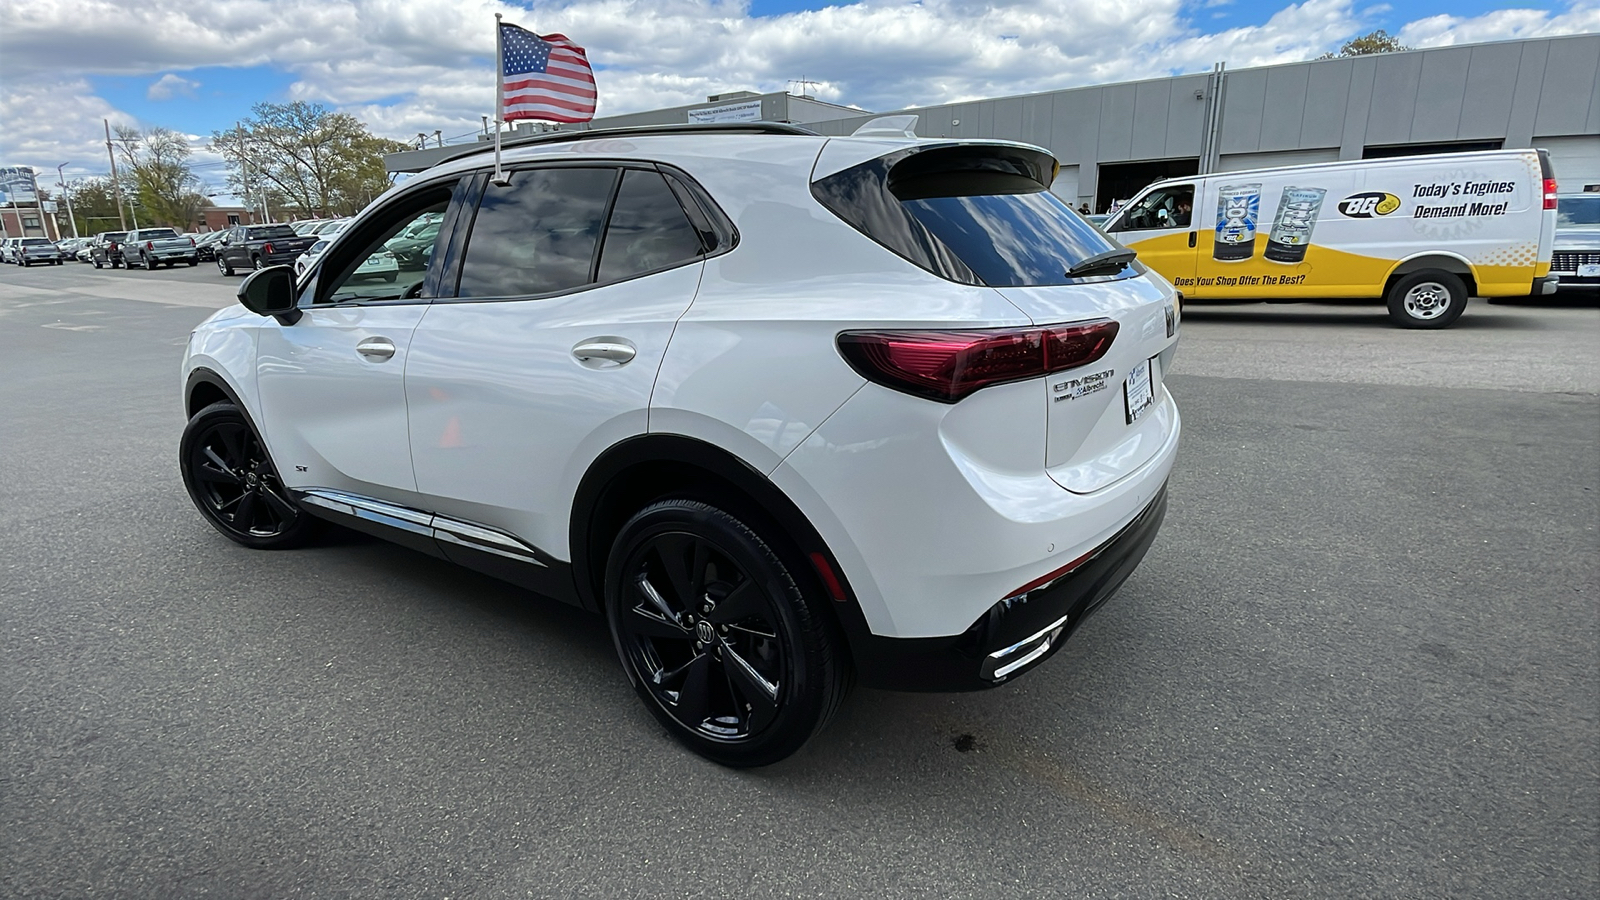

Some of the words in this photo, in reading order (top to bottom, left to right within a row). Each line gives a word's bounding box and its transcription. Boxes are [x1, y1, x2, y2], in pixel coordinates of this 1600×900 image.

[1412, 182, 1461, 199] Today's
[1463, 180, 1515, 196] Engines
[1225, 199, 1248, 229] MOA
[1345, 196, 1380, 215] BG
[1413, 202, 1467, 219] Demand
[1468, 201, 1509, 217] More!
[1174, 276, 1195, 286] Does
[1196, 276, 1215, 286] Your
[1216, 276, 1238, 287] Shop
[1238, 275, 1260, 285] Offer
[1262, 275, 1278, 285] The
[1278, 274, 1306, 285] Best?
[295, 465, 309, 473] ST
